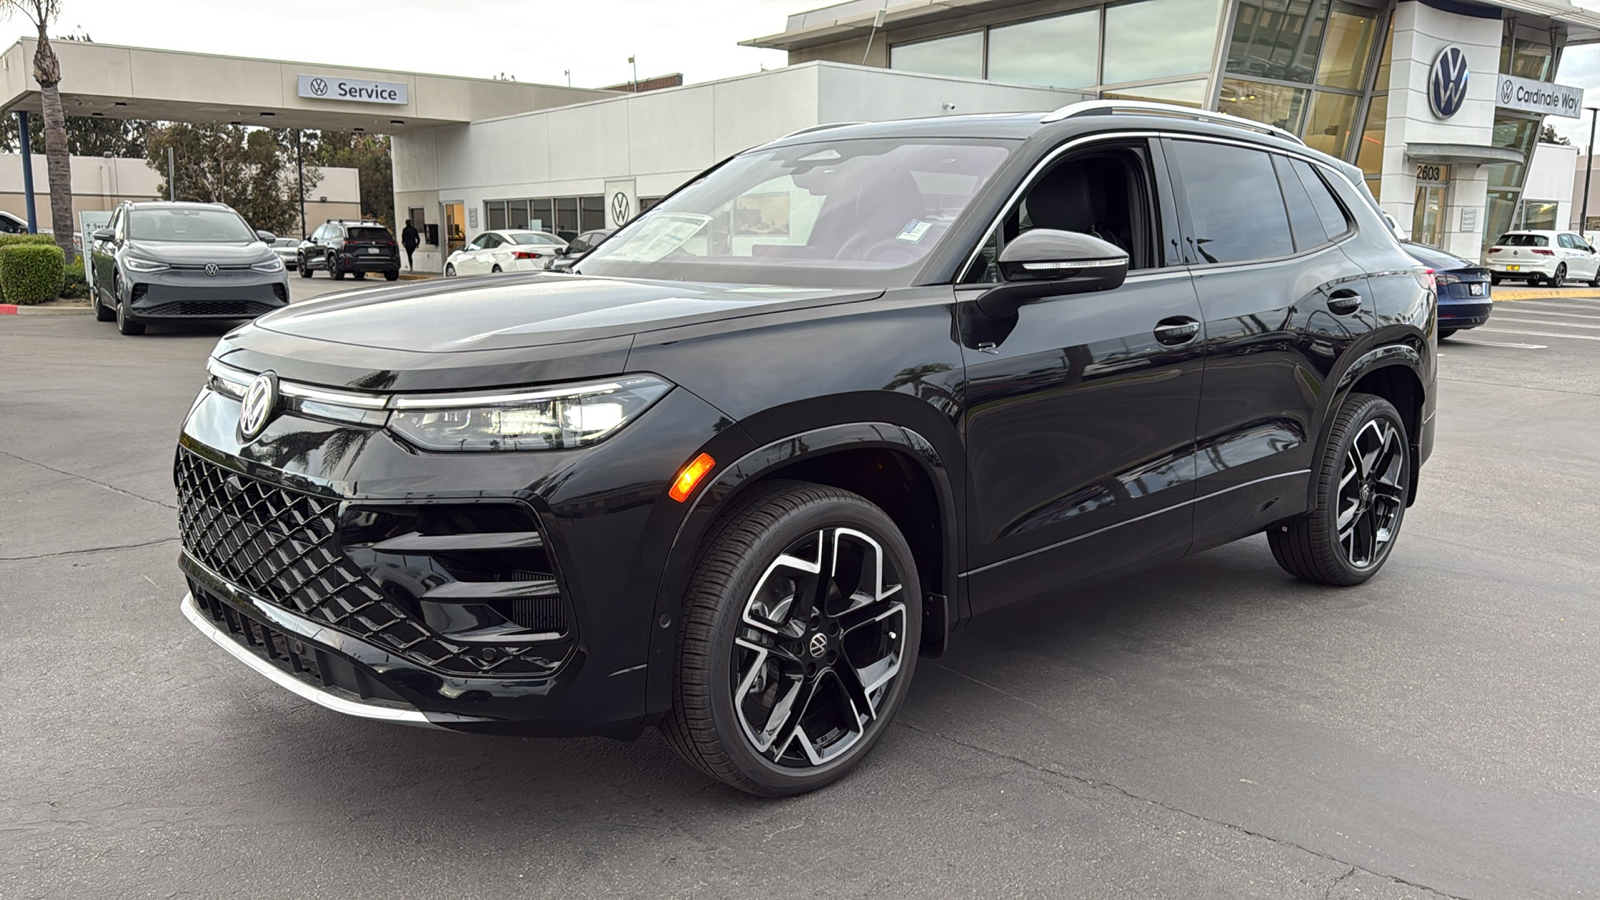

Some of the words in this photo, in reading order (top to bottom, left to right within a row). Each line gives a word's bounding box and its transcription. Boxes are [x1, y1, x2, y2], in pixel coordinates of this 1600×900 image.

[338, 82, 397, 100] Service
[1516, 86, 1559, 107] Cardinale
[1561, 92, 1579, 113] Way
[1417, 165, 1440, 180] 2603
